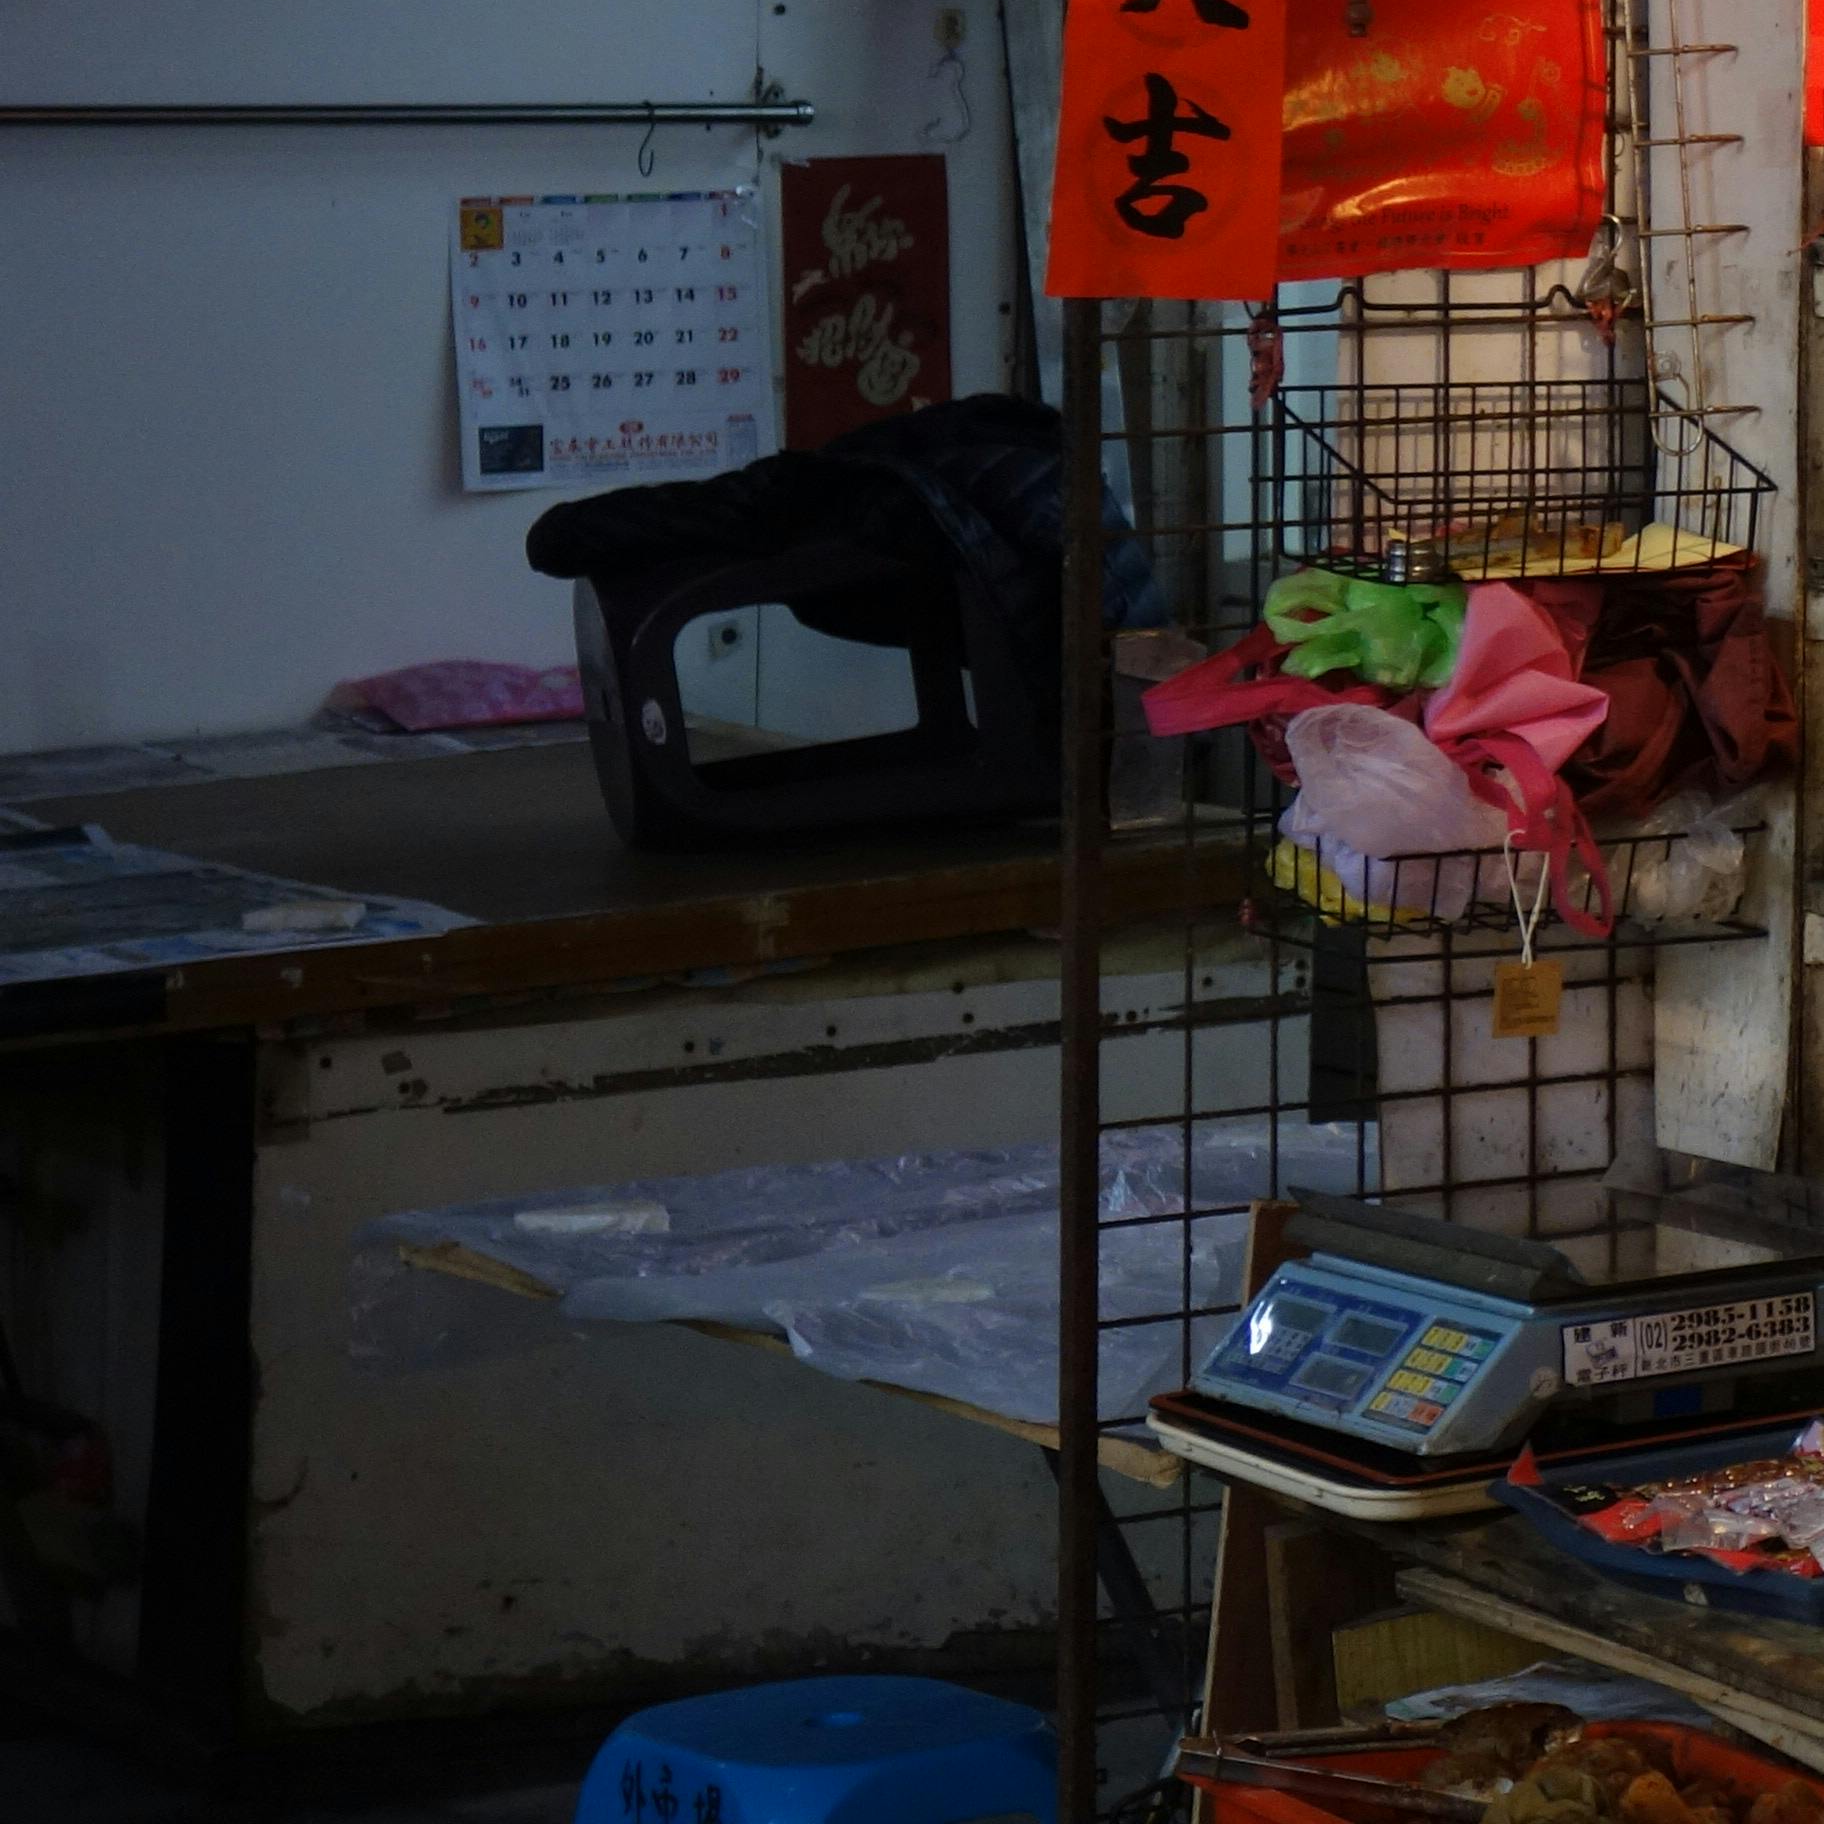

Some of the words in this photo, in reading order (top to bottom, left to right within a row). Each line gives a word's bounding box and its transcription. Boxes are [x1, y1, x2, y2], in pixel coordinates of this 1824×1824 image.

[511, 252, 521, 266] 3
[553, 251, 564, 265] 4
[596, 250, 605, 264] 5
[638, 249, 647, 263] 6
[679, 247, 689, 261] 7
[720, 246, 730, 259] 8
[508, 294, 527, 308] 10
[551, 293, 568, 306] 11
[593, 291, 611, 305] 12
[635, 289, 653, 304] 13
[676, 288, 695, 302] 14
[718, 287, 737, 301] 15
[470, 295, 479, 308] 9
[551, 334, 570, 349] 18
[594, 333, 612, 346] 19
[634, 331, 654, 346] 20
[675, 330, 693, 344] 21
[718, 328, 738, 342] 22
[469, 338, 486, 351] 16
[509, 336, 528, 350] 17
[550, 376, 570, 391] 25
[592, 375, 613, 388] 26
[634, 373, 654, 387] 27
[676, 371, 696, 386] 28
[717, 369, 741, 384] 29
[1671, 1295, 1811, 1332] 2985-1158
[1640, 1319, 1668, 1354] (02)
[1672, 1316, 1811, 1352] 2982-6383
